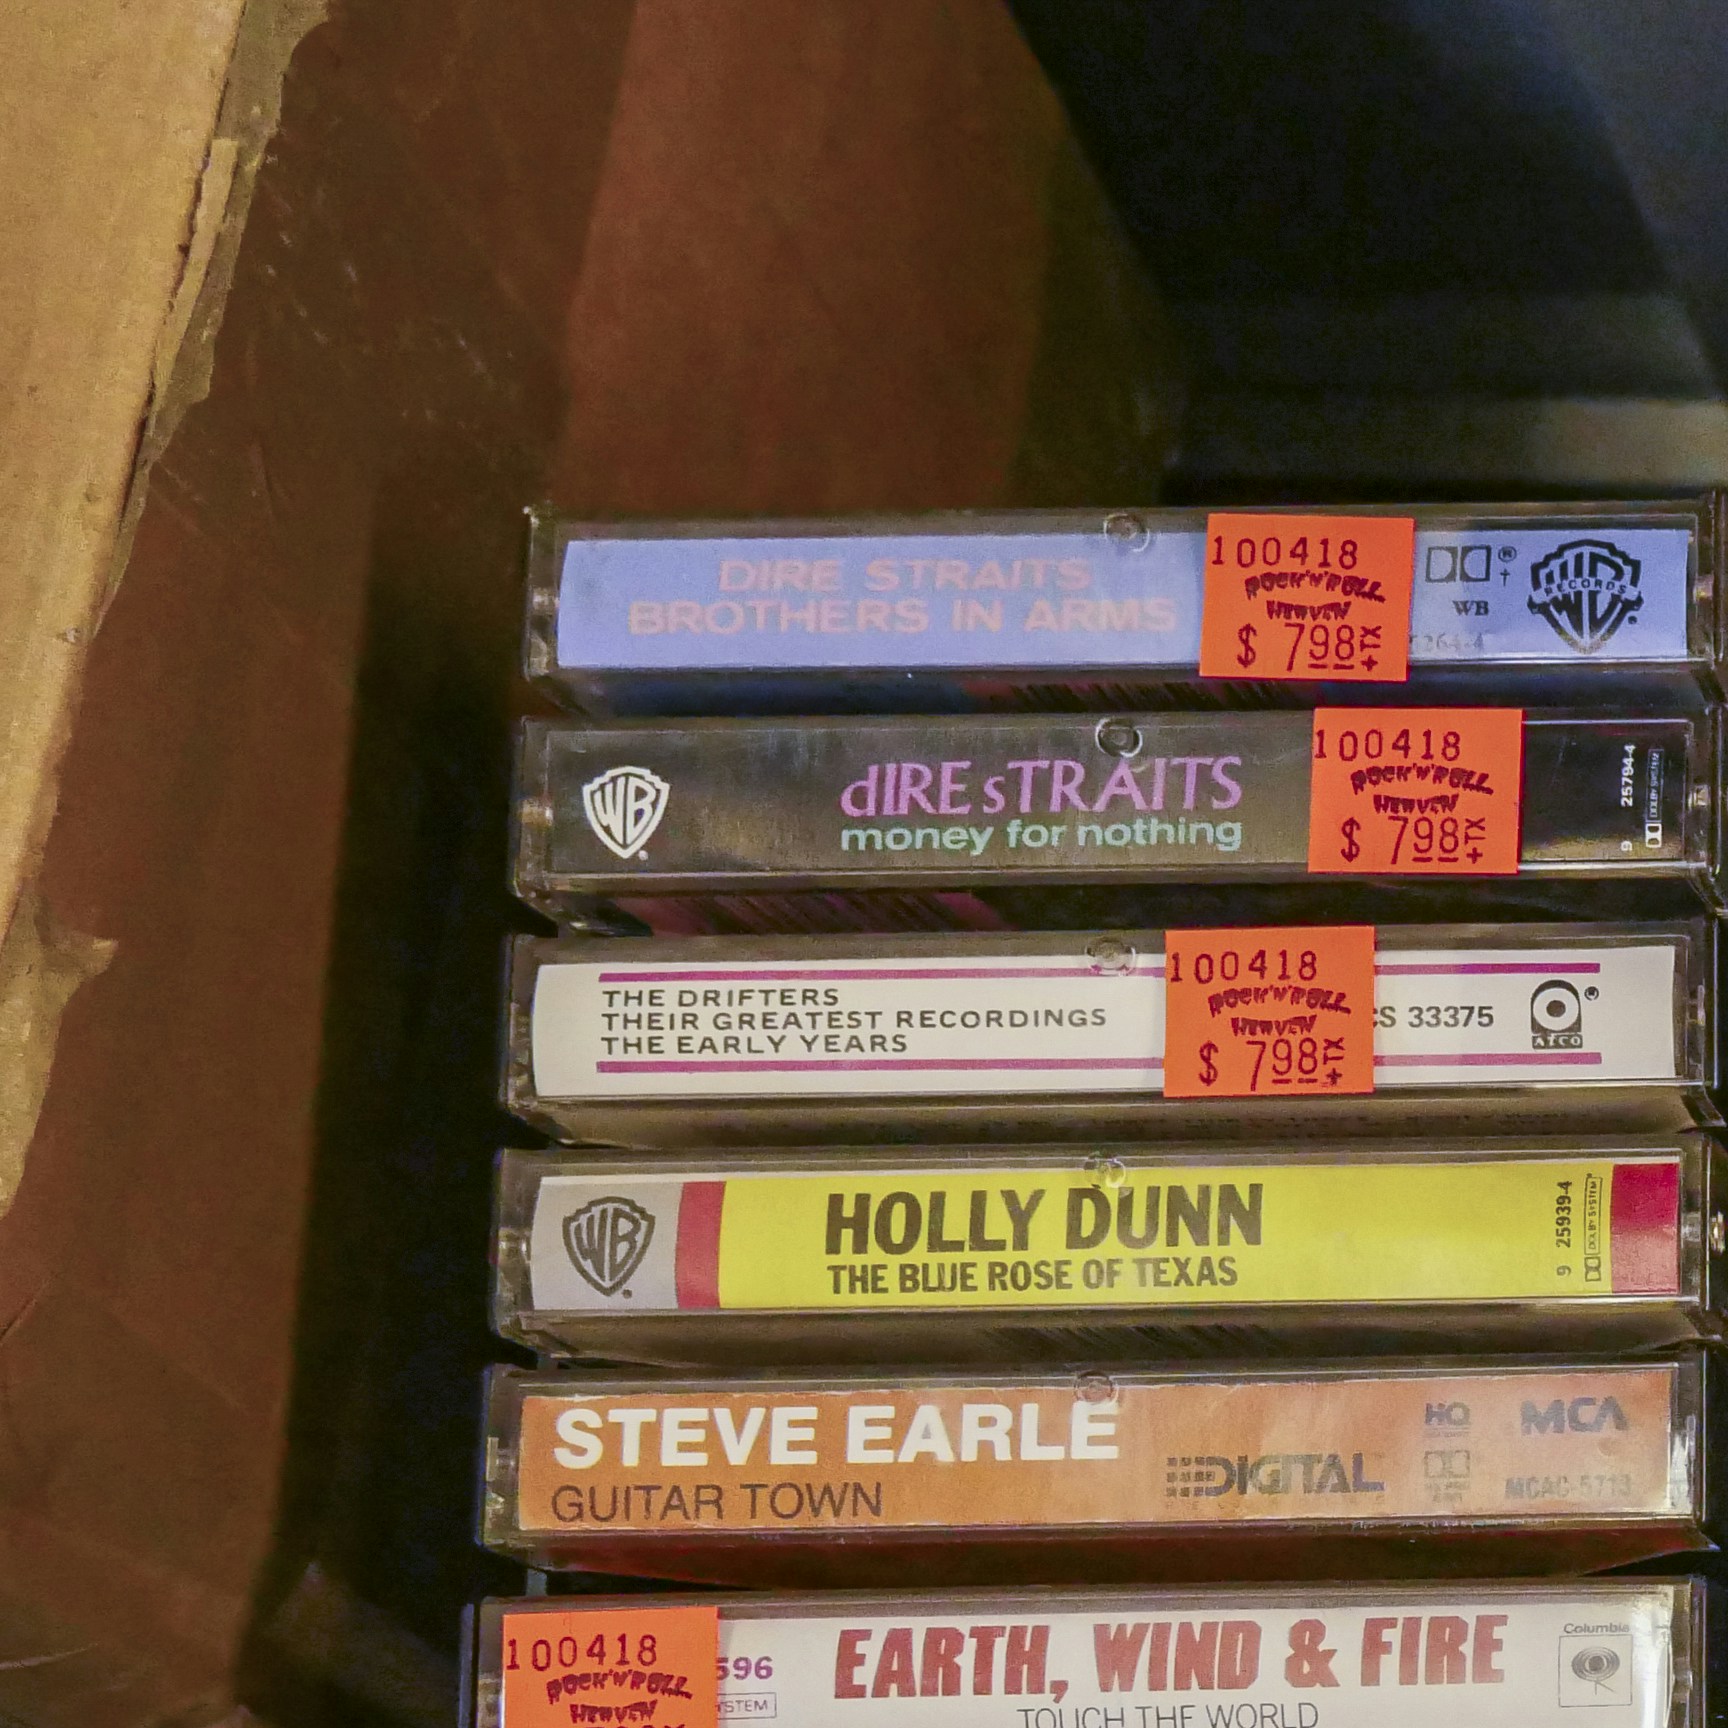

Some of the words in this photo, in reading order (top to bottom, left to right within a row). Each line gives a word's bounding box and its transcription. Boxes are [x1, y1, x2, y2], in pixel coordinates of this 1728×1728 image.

[717, 560, 839, 595] DIRE
[864, 559, 1094, 594] STRAITS
[628, 598, 930, 637] BROTHERS
[950, 597, 1001, 634] IN
[1023, 594, 1179, 634] ARMS
[839, 825, 994, 857] money
[1007, 819, 1063, 849] for
[1077, 815, 1242, 852] nothing
[602, 989, 666, 1007] THE
[678, 988, 840, 1007] DRIFTERS
[601, 1011, 701, 1031] THEIR
[712, 1011, 879, 1031] GREATEST
[896, 1008, 1107, 1029] RECORDINGS
[825, 1189, 1047, 1256] HOLLY
[1063, 1183, 1263, 1251] DUNN
[553, 1405, 819, 1471] STEVE
[845, 1399, 1120, 1464] EARLE
[550, 1484, 724, 1523] GUITAR
[739, 1482, 884, 1520] TOWN
[506, 1634, 659, 1672] 100418
[833, 1624, 1071, 1703] EARTH,
[1093, 1620, 1263, 1693] WIND
[1283, 1618, 1340, 1689] &
[1359, 1614, 1509, 1688] FIRE
